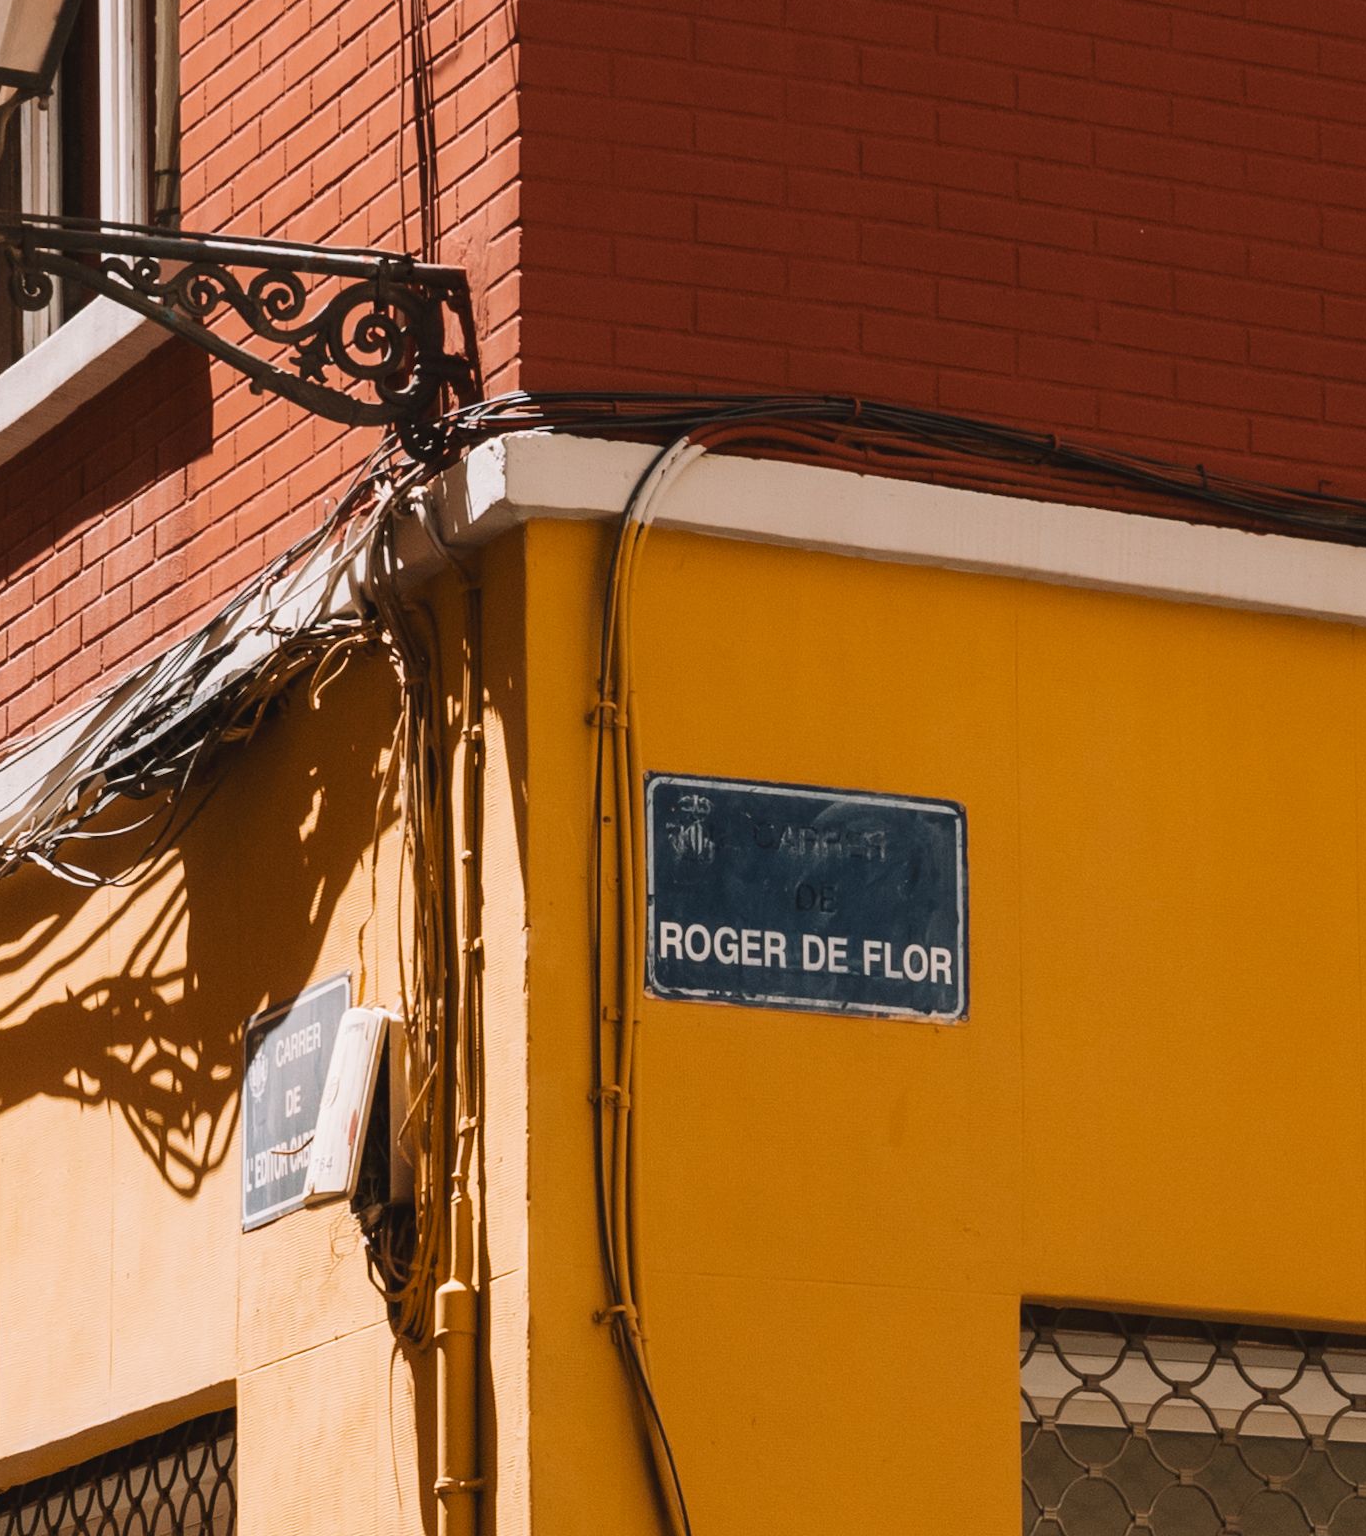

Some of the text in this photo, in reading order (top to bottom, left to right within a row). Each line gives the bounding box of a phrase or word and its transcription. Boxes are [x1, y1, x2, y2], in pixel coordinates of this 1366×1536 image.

[659, 921, 954, 985] ROGER DE FLOR
[275, 1022, 322, 1068] CARRER
[286, 1086, 301, 1117] DE
